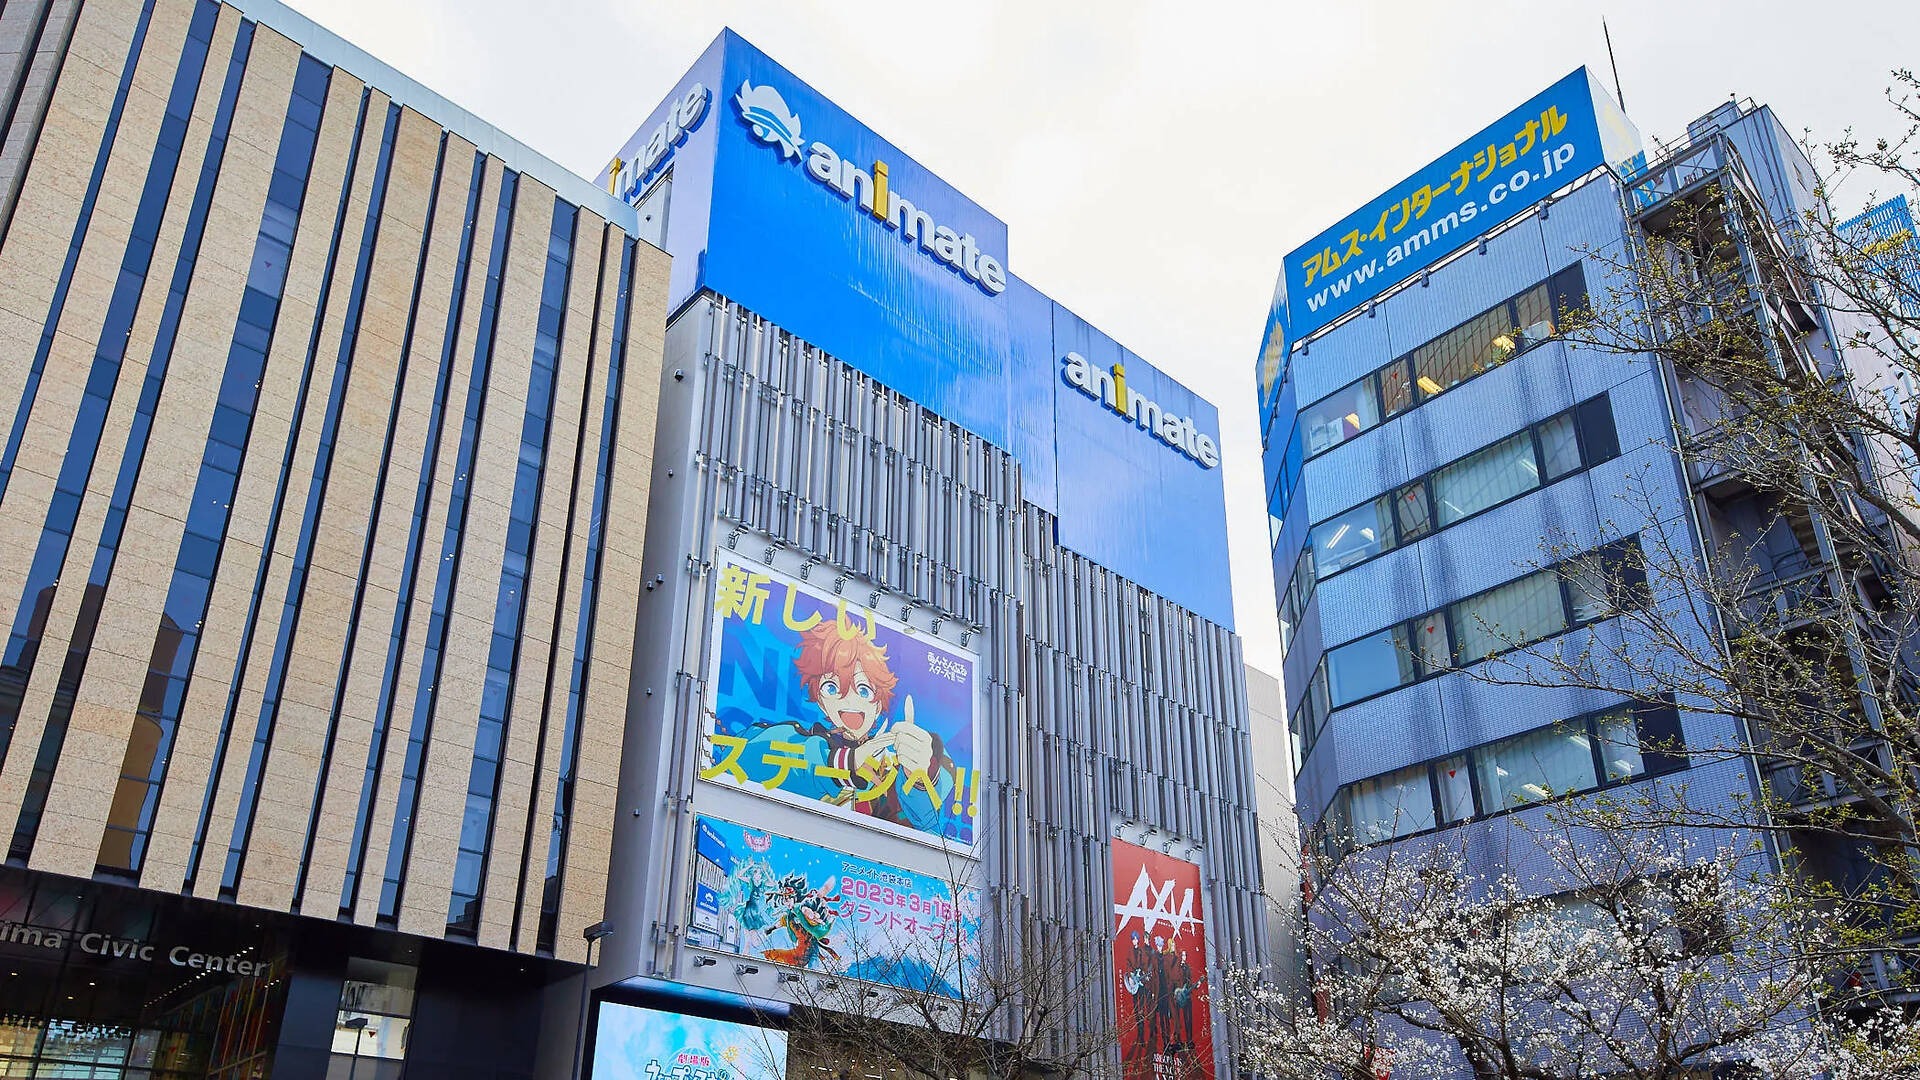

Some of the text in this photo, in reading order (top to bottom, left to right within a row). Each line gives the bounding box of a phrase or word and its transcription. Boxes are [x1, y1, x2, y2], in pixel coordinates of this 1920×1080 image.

[807, 140, 1008, 294] animate
[1306, 143, 1576, 313] www.amms.co.jp
[1063, 350, 1220, 468] animate
[714, 564, 877, 642] 新しい
[80, 933, 155, 962] Civic
[169, 946, 269, 977] Center
